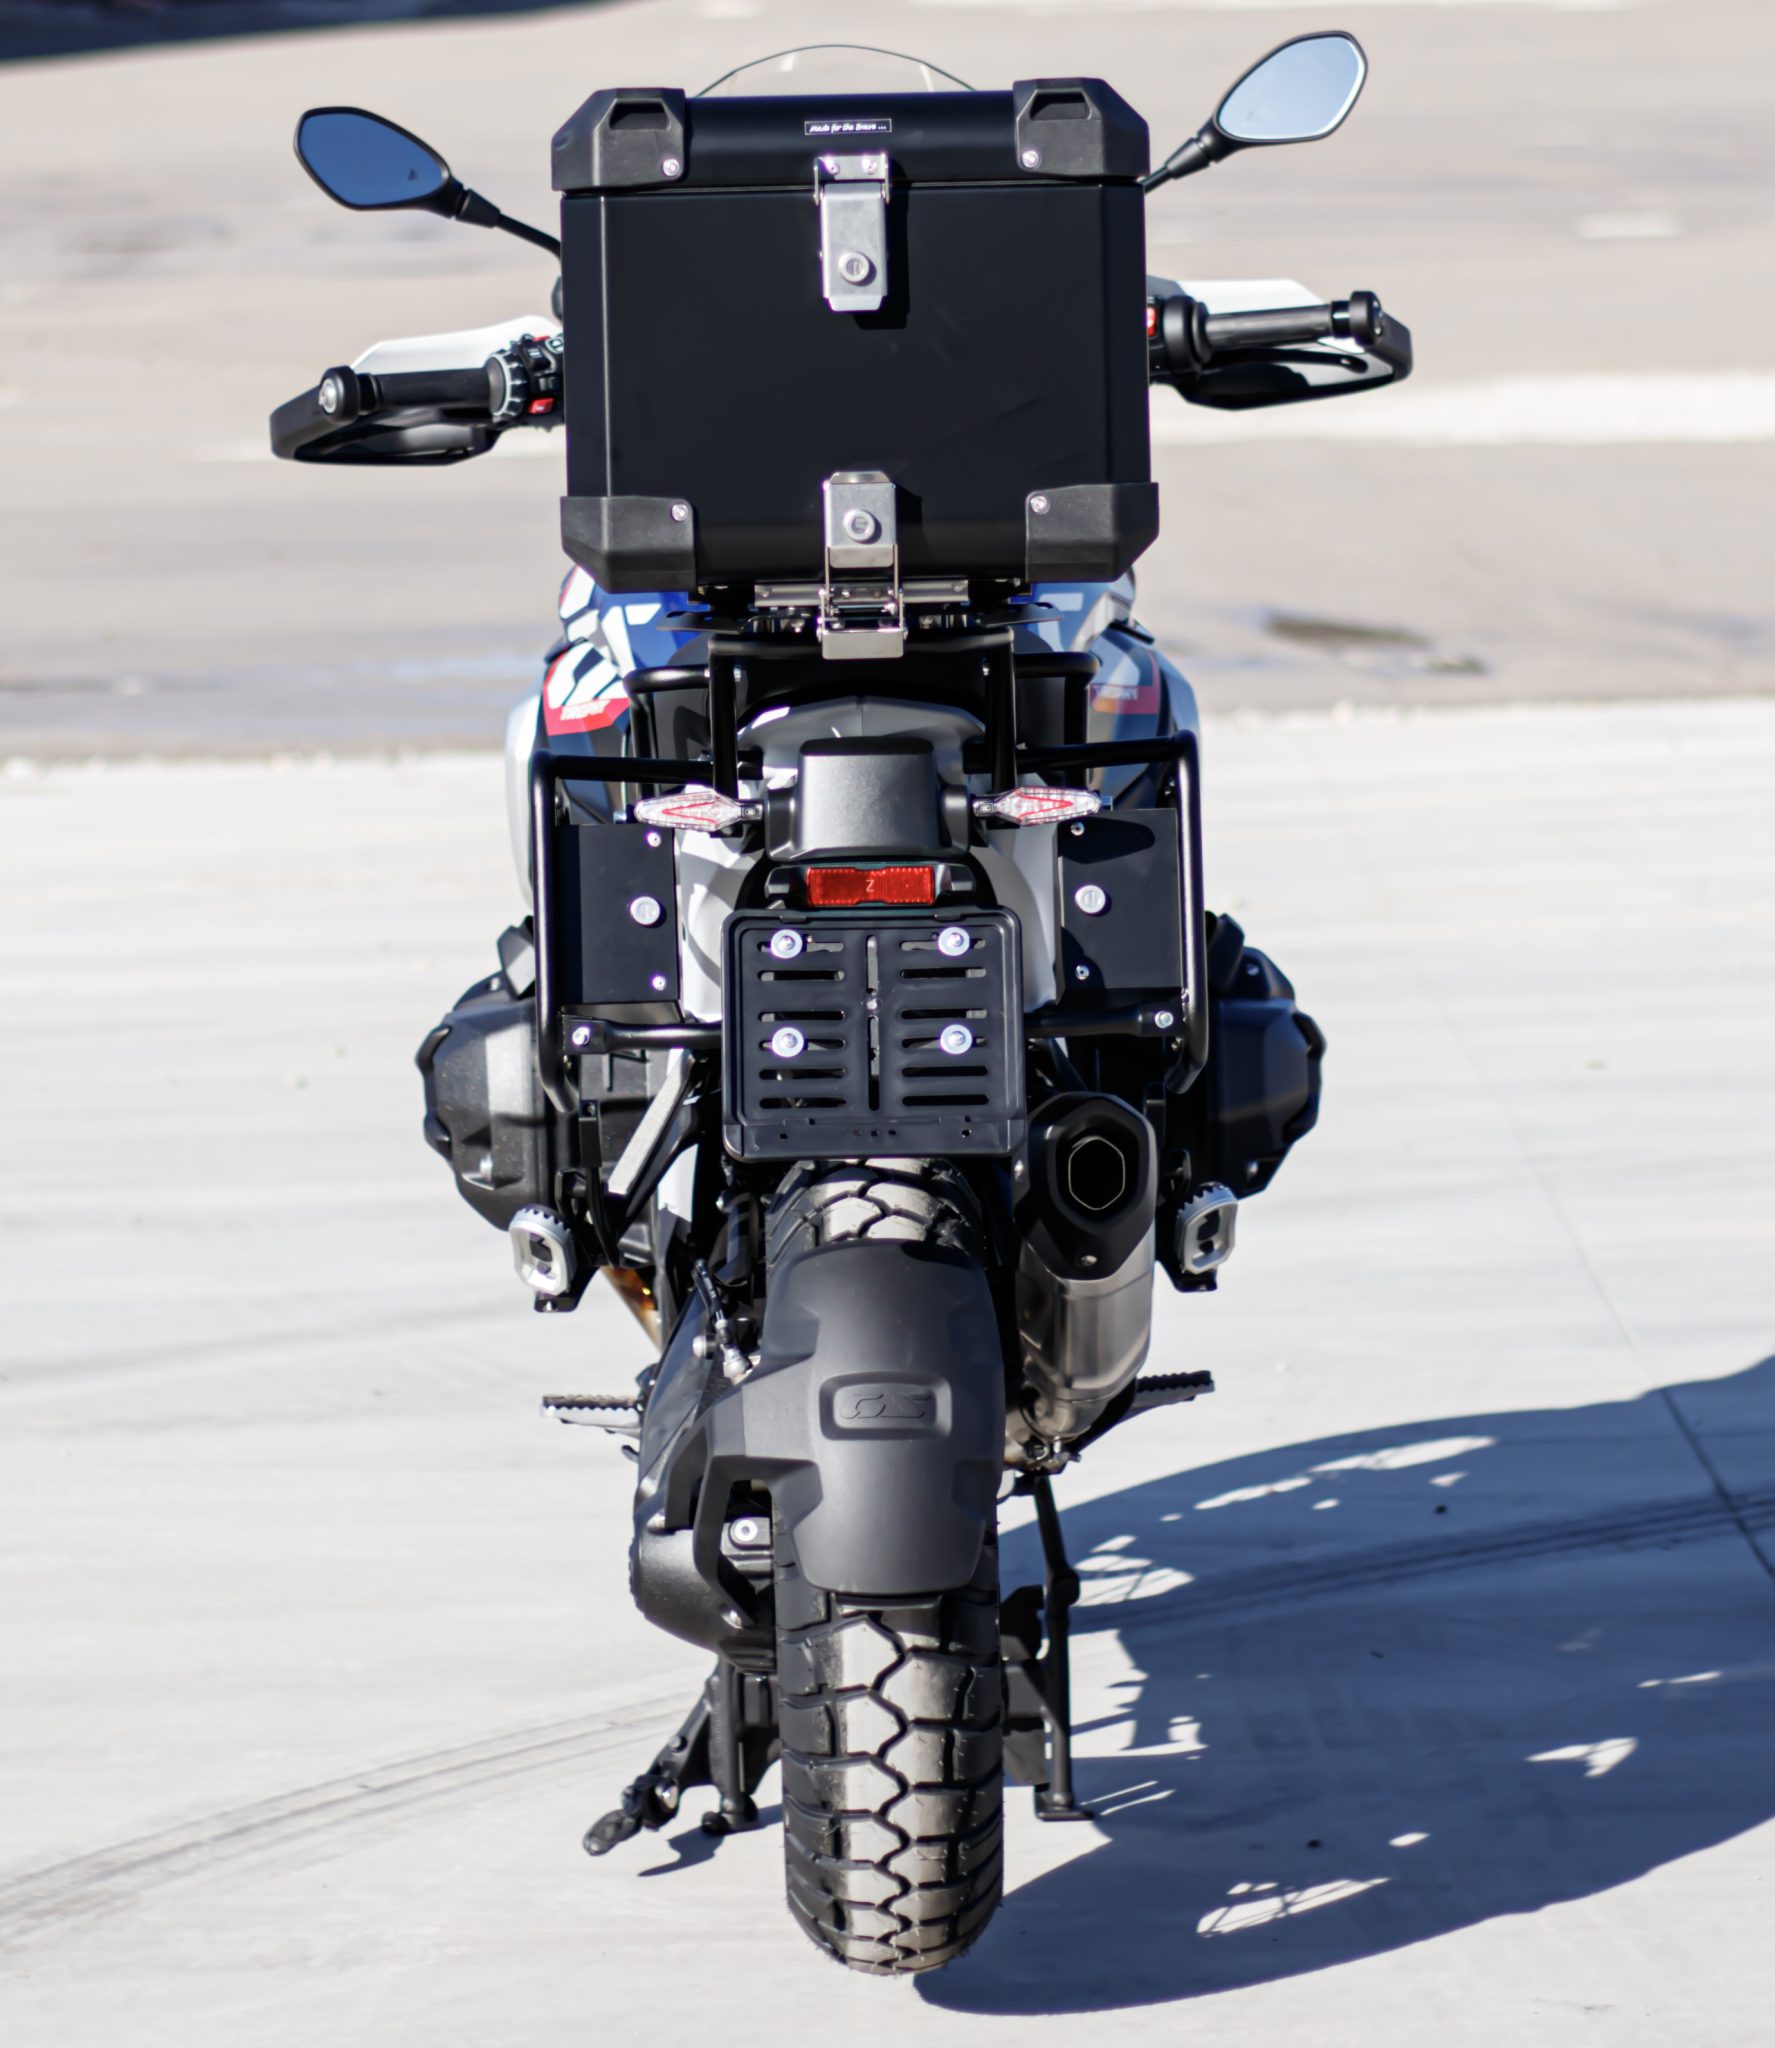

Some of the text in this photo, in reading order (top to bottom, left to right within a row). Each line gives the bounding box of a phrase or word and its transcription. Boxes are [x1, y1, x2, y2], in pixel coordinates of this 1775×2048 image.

[809, 124, 830, 133] Made
[831, 123, 843, 134] for
[842, 122, 854, 131] the
[865, 879, 876, 893] Z
[840, 1392, 933, 1420] GS
